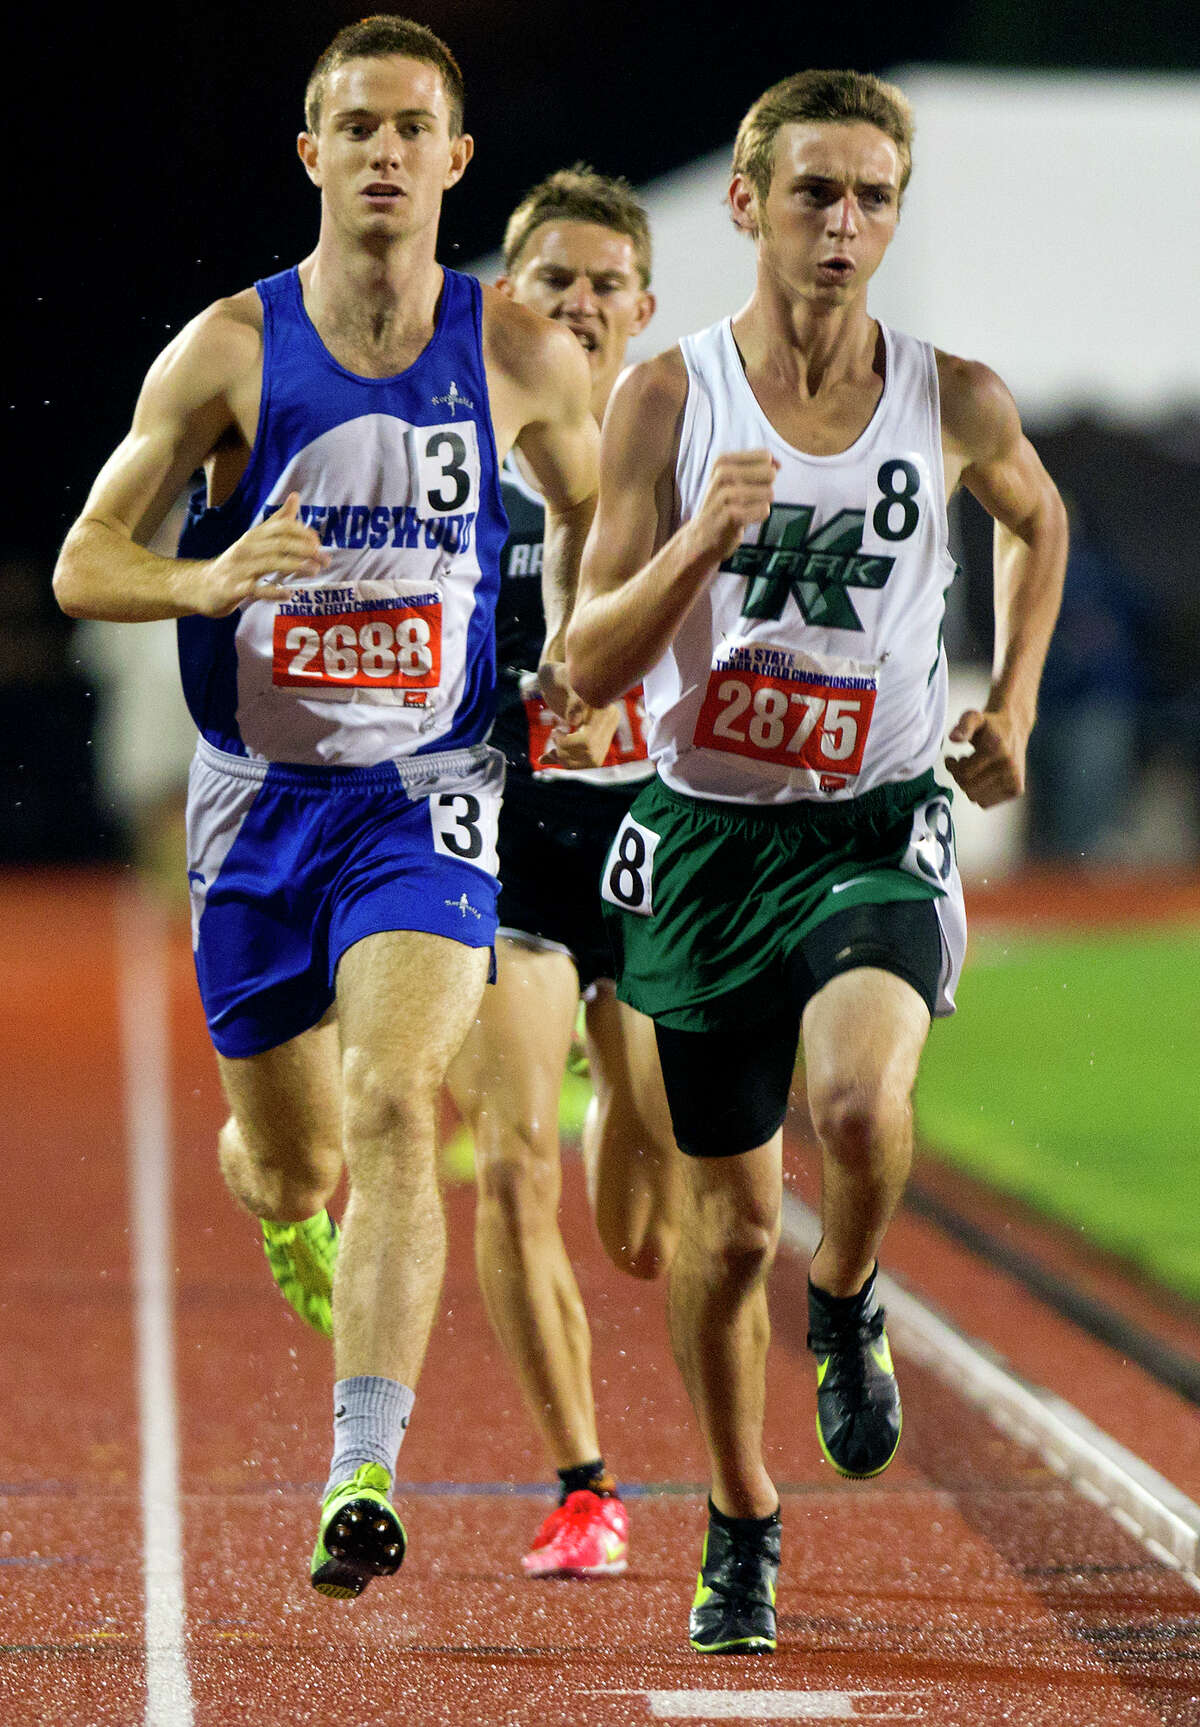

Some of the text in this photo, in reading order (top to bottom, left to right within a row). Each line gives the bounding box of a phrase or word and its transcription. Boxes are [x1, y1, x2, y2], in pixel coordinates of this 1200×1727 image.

[425, 432, 470, 512] 3
[872, 459, 921, 542] 8
[279, 603, 314, 616] TRACK
[324, 601, 351, 615] FIELD
[354, 593, 440, 612] CHAMPIONSHIPS
[314, 587, 354, 604] STATE
[285, 617, 433, 679] 2688
[716, 659, 751, 672] TRACK
[761, 664, 790, 680] FIELD
[791, 669, 877, 690] CHAMPIONSHIPS
[754, 648, 794, 667] STATE
[712, 680, 861, 761] 2875
[438, 793, 483, 859] 3
[609, 827, 646, 907] 8
